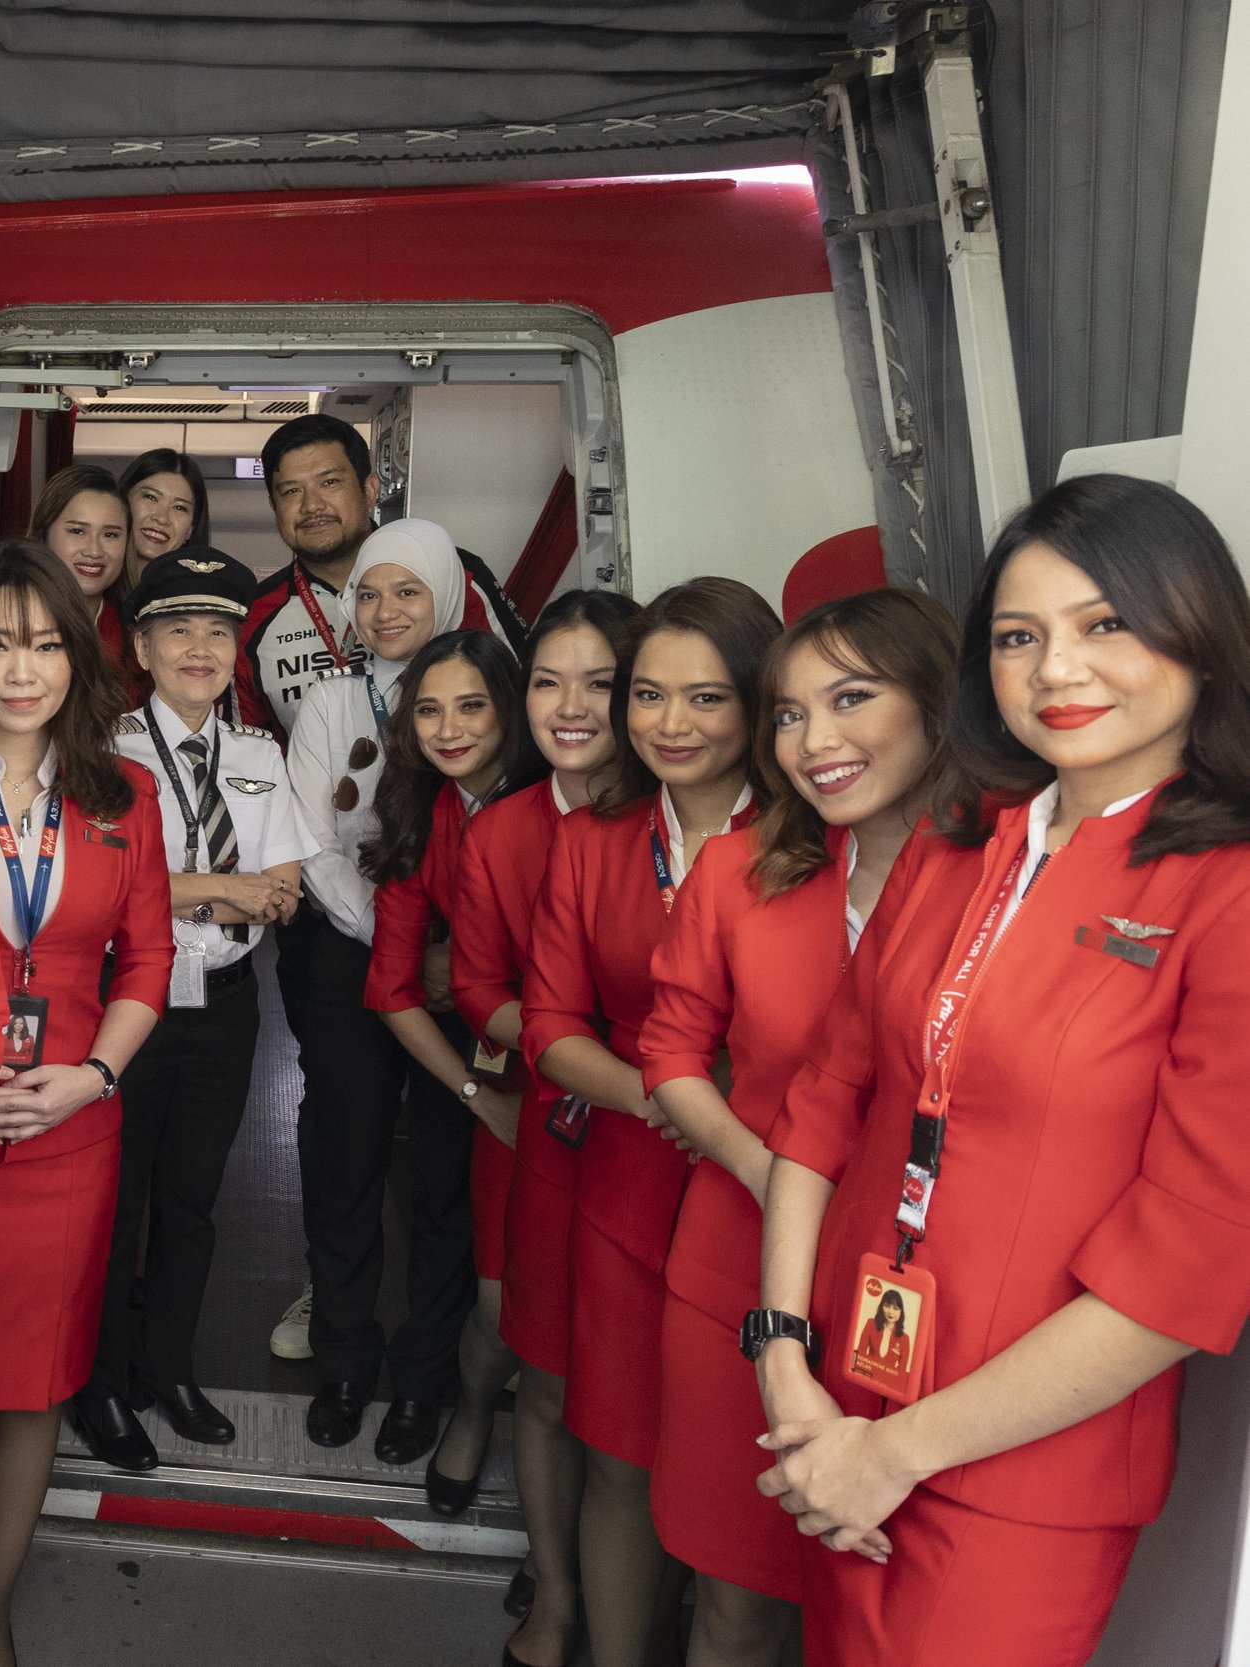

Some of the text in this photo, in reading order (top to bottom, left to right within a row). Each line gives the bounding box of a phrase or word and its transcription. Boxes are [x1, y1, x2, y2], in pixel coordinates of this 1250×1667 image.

[276, 624, 336, 645] TOSHIA
[954, 903, 1000, 983] ONE FOR ALL
